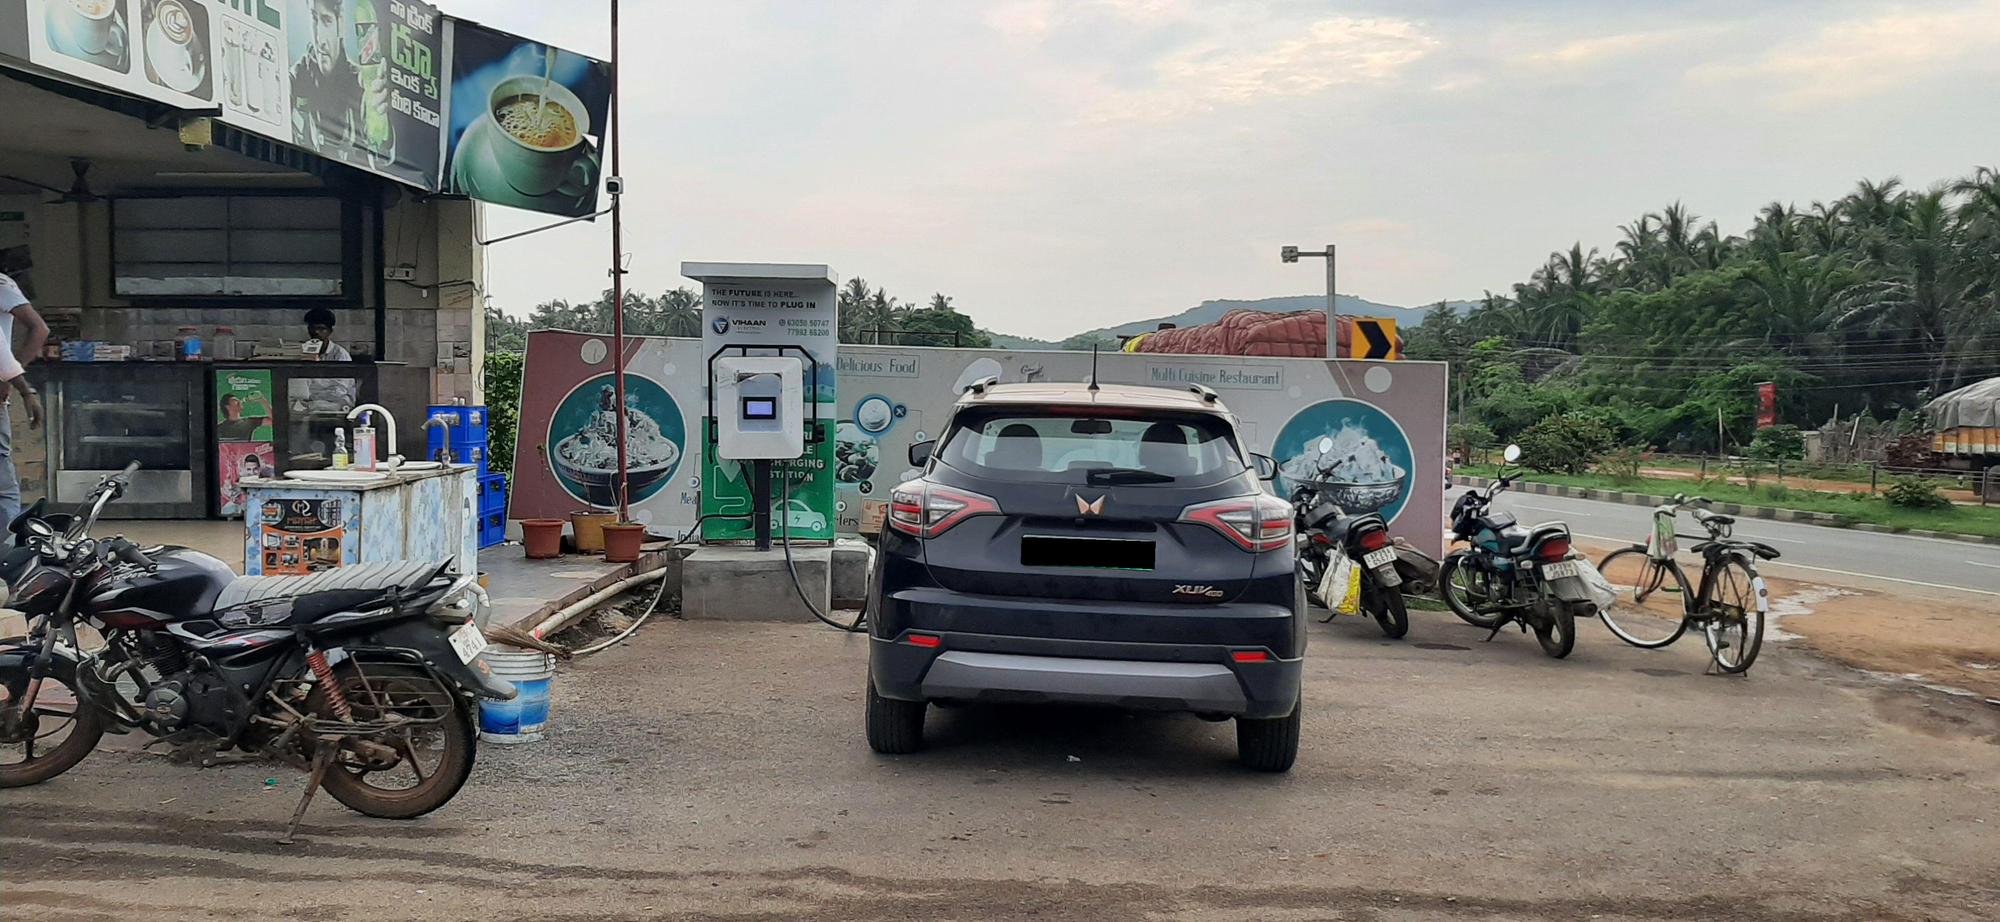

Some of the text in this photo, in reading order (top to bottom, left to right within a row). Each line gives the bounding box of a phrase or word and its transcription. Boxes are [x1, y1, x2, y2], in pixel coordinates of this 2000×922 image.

[711, 288, 727, 297] THE
[728, 289, 761, 298] FUTURE
[763, 290, 771, 298] IS
[711, 299, 730, 307] NOW
[748, 300, 766, 309] TIME
[768, 300, 779, 309] TO
[780, 300, 804, 309] PLUG
[806, 301, 816, 310] IN
[731, 319, 767, 327] VIHAAN
[836, 356, 916, 374] Delicious Food
[1151, 367, 1279, 385] Multi Cuisine Restaurant
